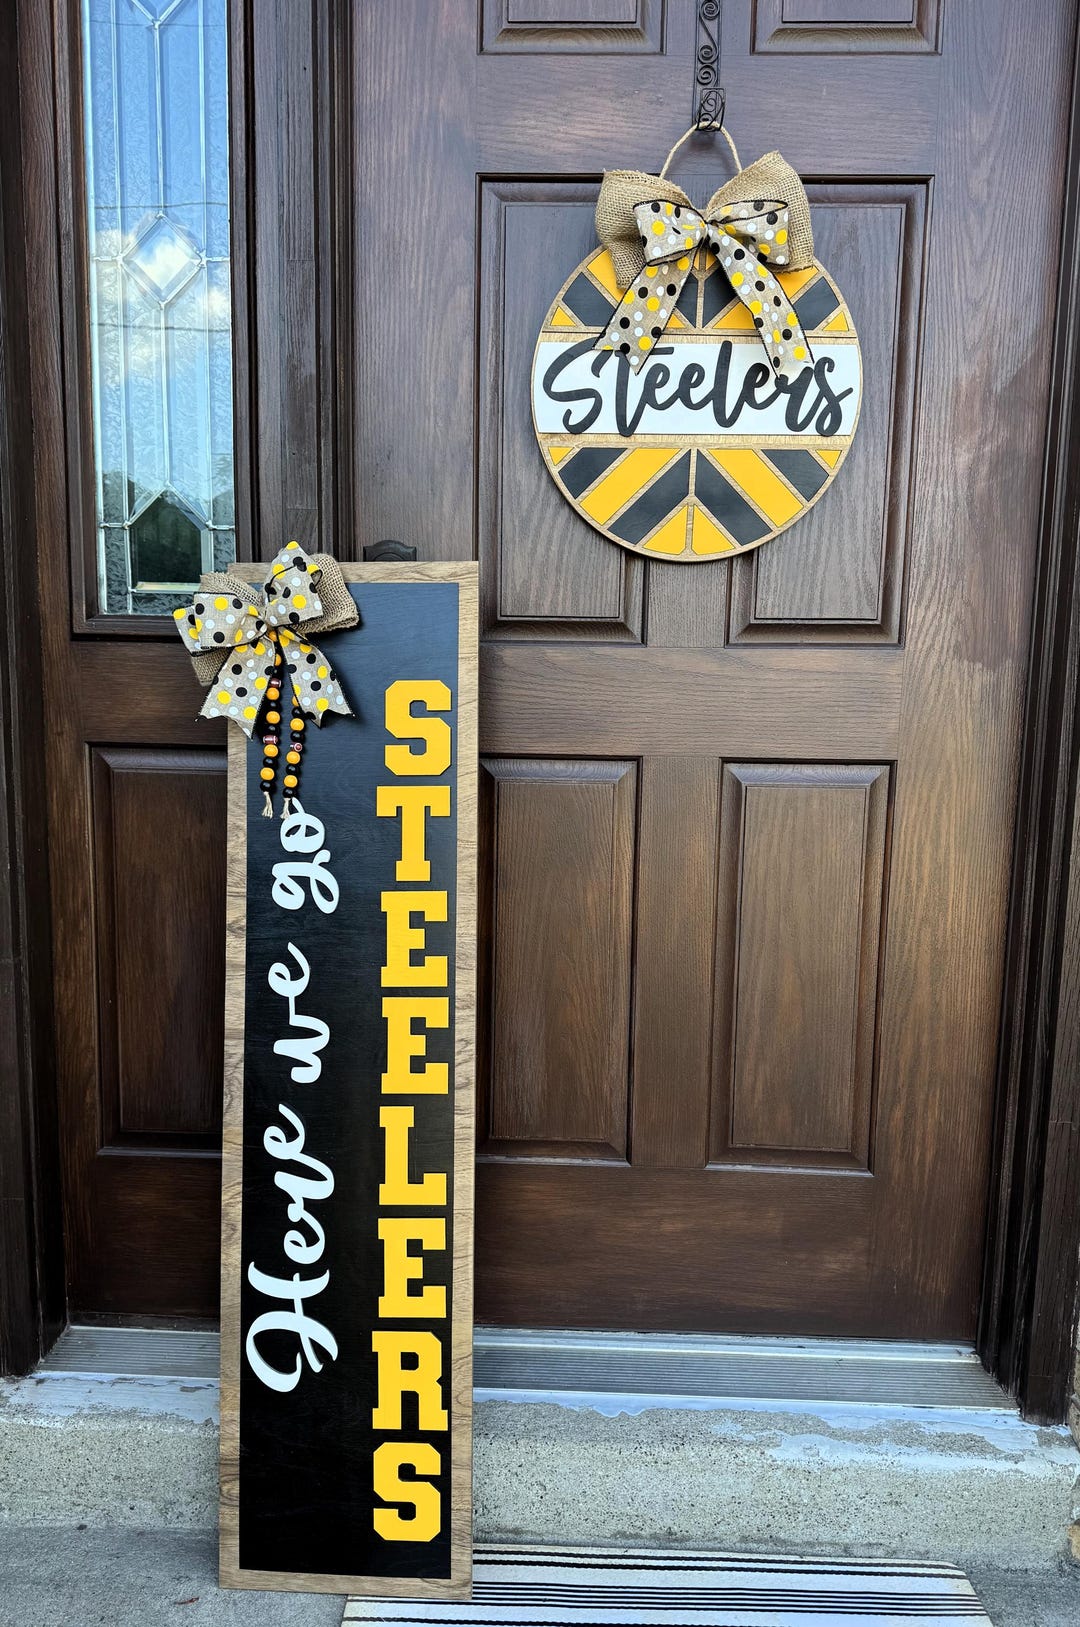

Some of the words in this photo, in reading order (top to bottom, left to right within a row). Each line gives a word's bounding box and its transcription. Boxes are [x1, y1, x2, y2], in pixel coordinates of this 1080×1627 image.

[543, 337, 853, 437] Steelers
[272, 797, 340, 914] go
[268, 942, 330, 1083] we
[371, 680, 452, 1542] STEELERS
[246, 1104, 339, 1392] Here
